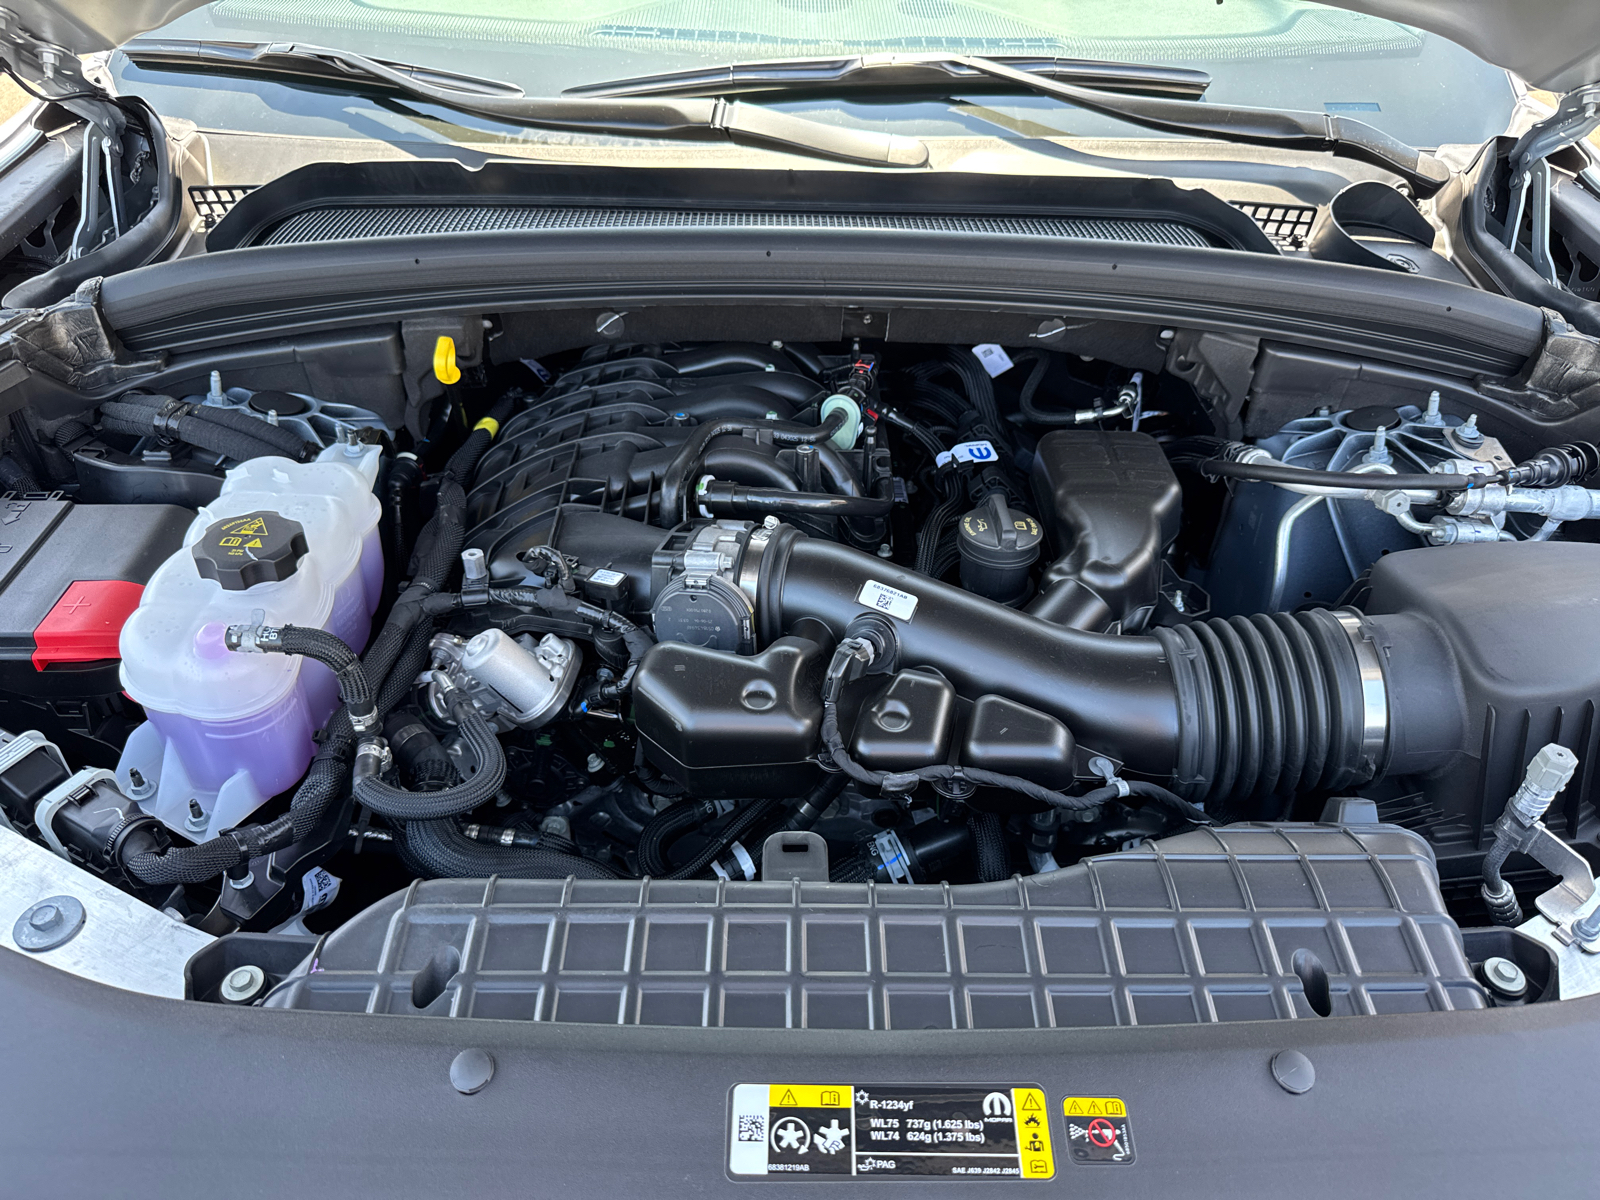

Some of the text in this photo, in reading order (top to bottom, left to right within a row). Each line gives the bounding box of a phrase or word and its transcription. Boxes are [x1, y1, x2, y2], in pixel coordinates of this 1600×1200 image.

[866, 840, 879, 857] ENG
[869, 1100, 914, 1111] R-1234yf
[870, 1118, 984, 1132] WL75 737g (1.625 lbs)
[870, 1131, 986, 1144] WL74 624g (1.375 lbs)
[876, 1158, 896, 1169] PAG
[951, 1166, 966, 1174] SAE
